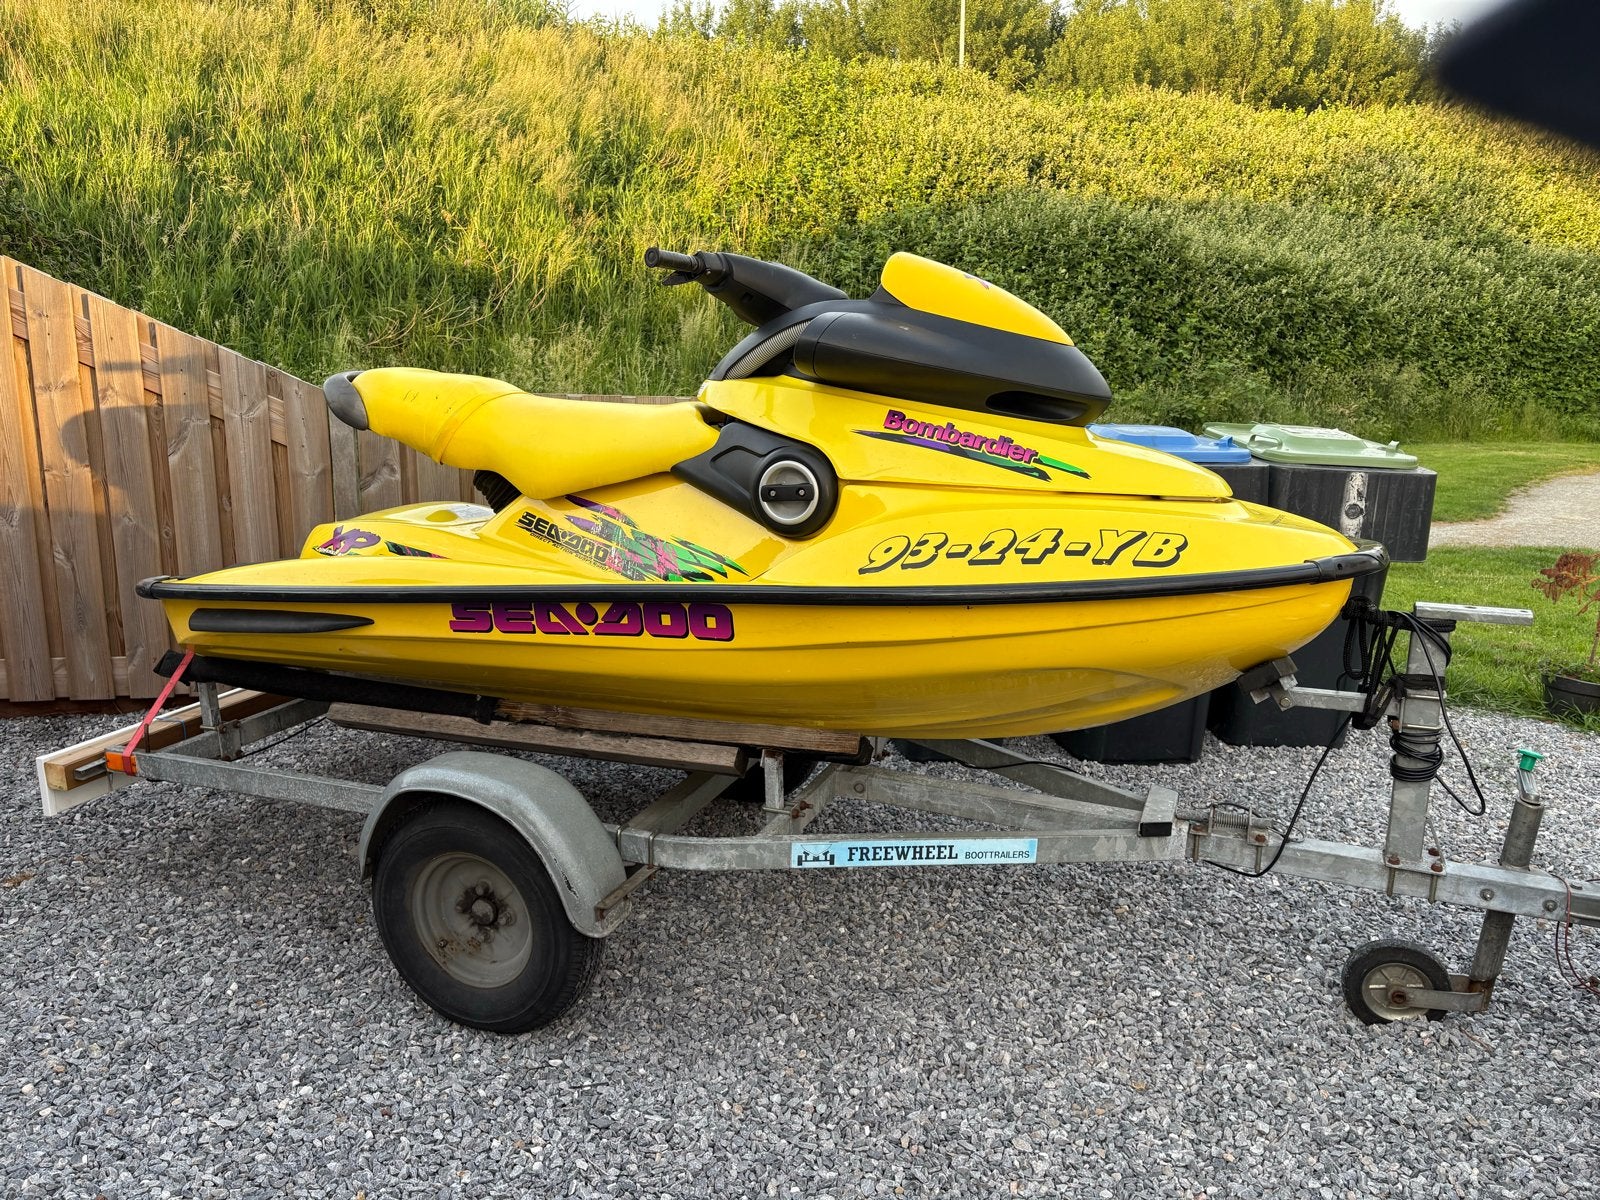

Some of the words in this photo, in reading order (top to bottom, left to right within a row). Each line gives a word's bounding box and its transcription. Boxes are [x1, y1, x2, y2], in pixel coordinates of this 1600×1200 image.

[884, 409, 1038, 464] Bombardier
[318, 525, 381, 554] XP
[529, 533, 551, 544] DIRECT
[858, 528, 1188, 575] 93-24-YB
[847, 845, 958, 862] FREEWHEEL
[964, 850, 1030, 860] BOOTTRAILERS
